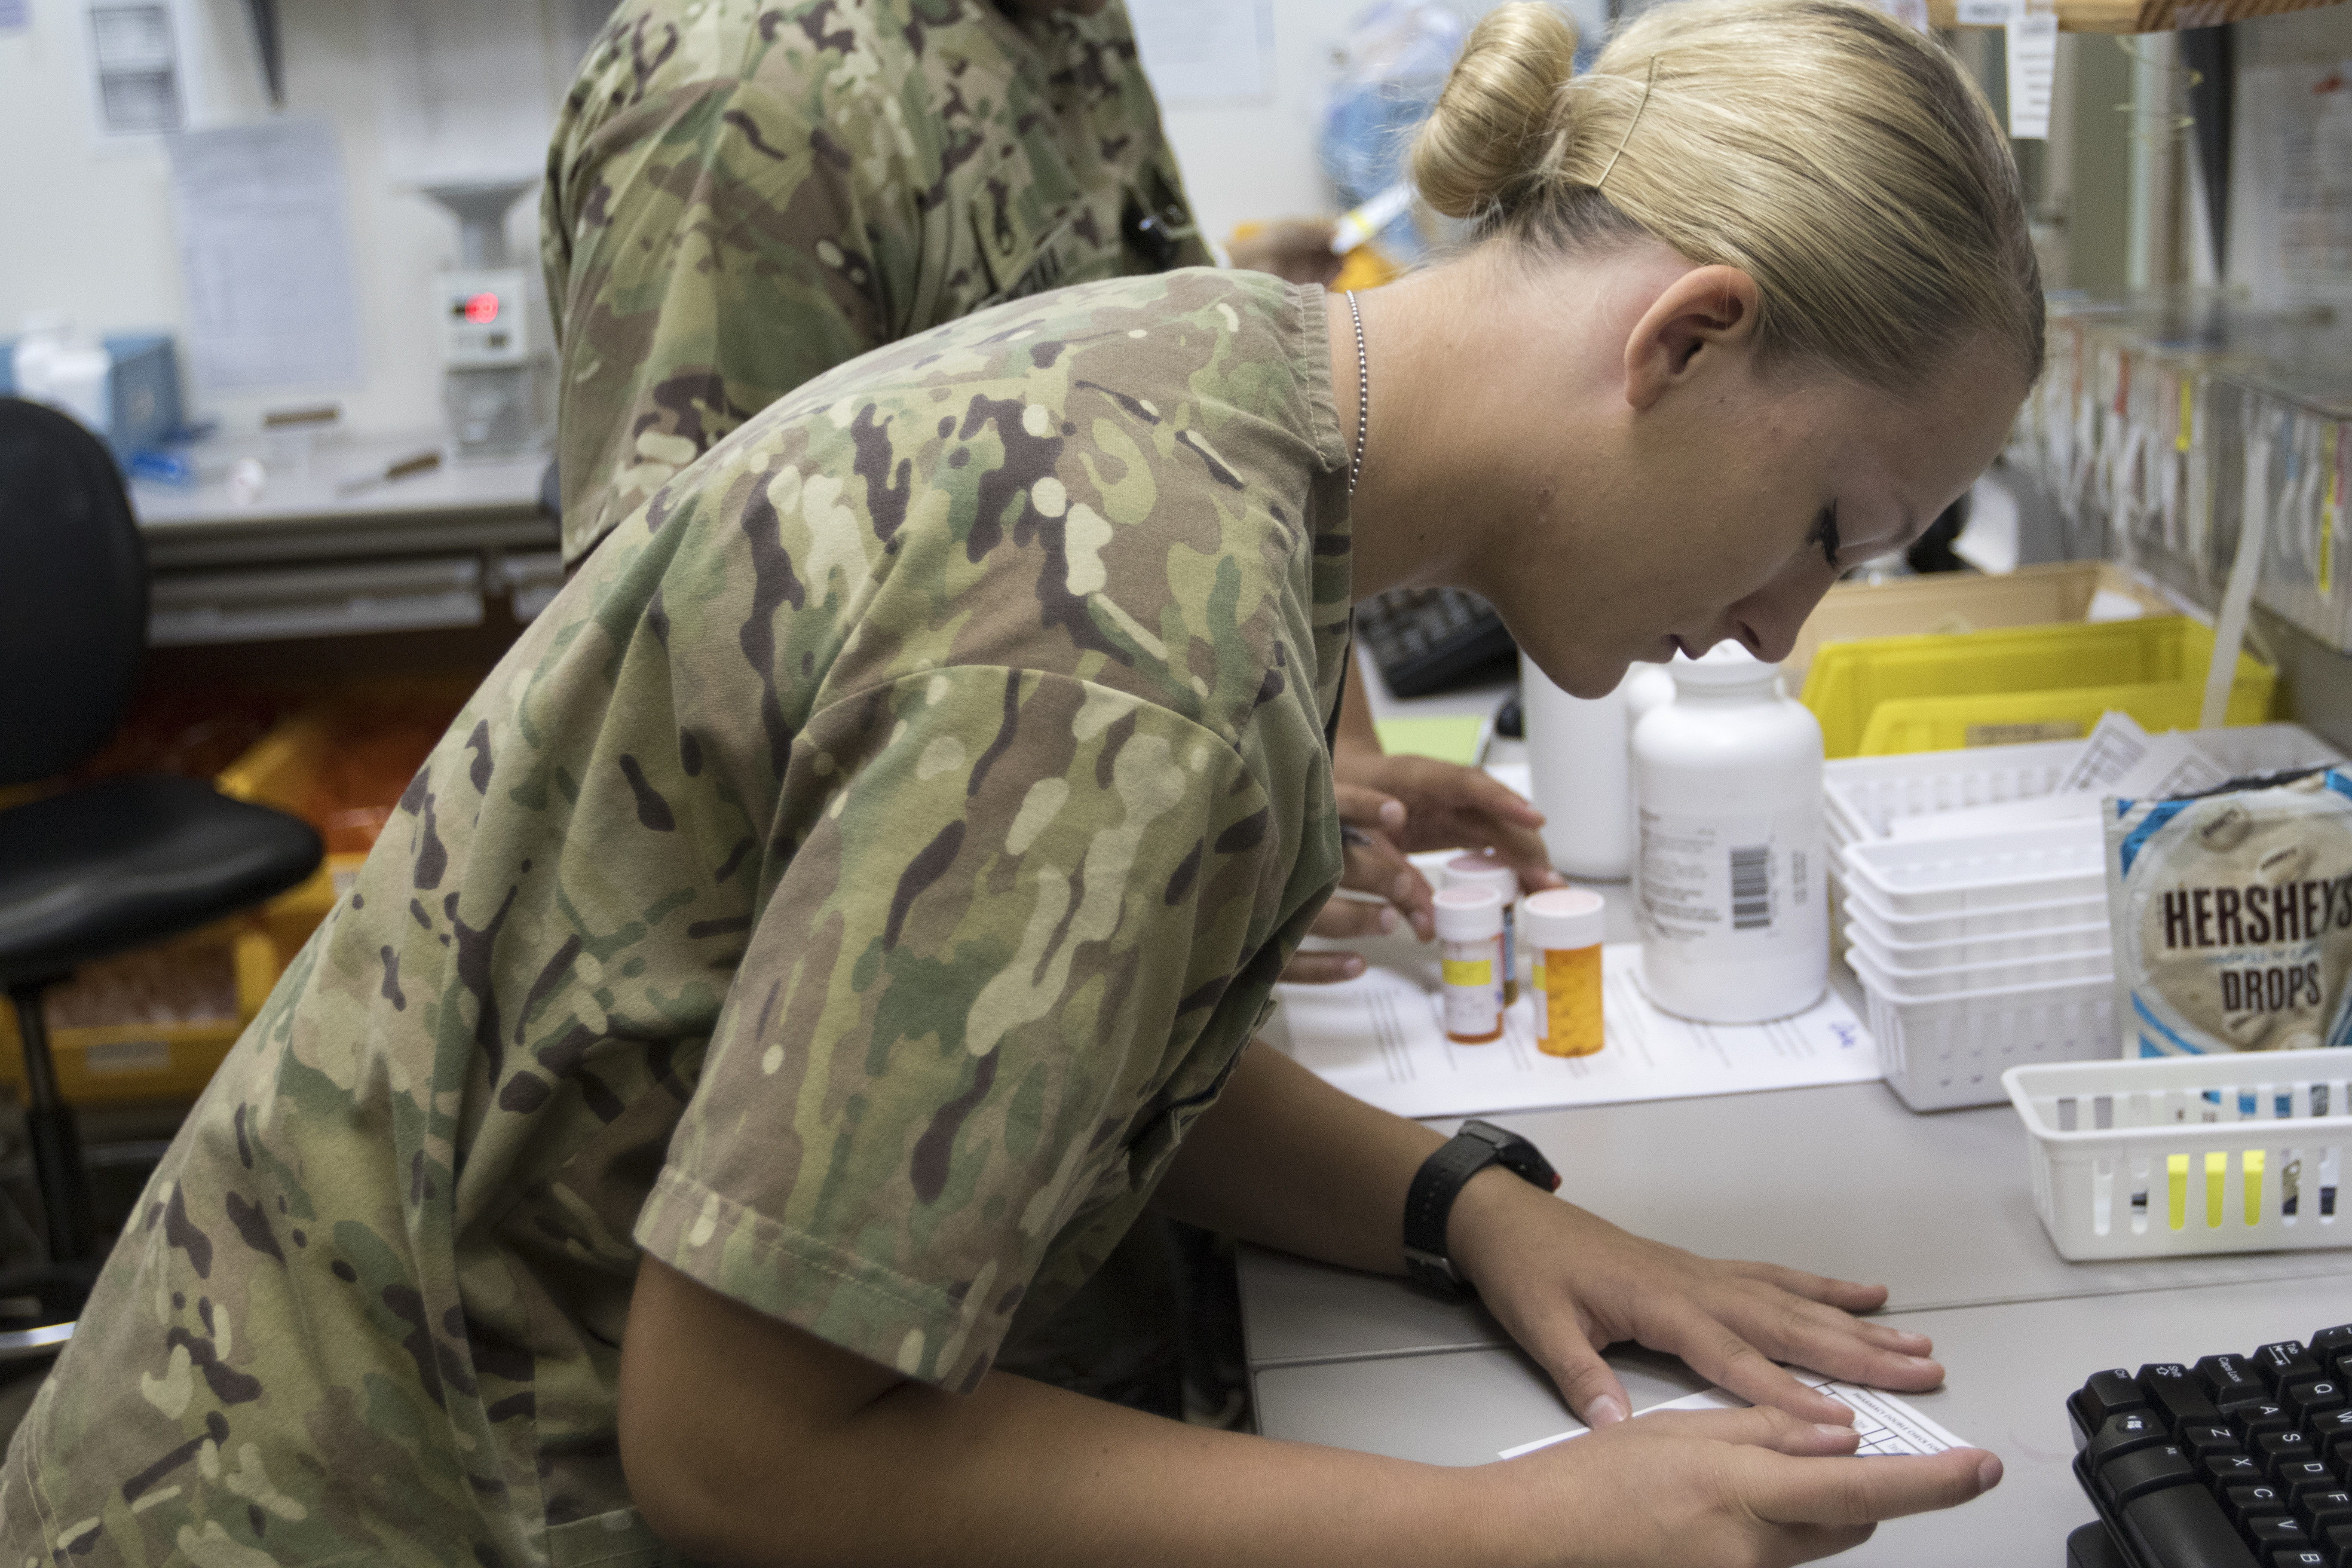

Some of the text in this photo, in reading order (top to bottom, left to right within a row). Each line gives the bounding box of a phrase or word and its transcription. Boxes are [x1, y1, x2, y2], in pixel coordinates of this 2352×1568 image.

[2221, 961, 2320, 1012] DROPS
[2286, 1342, 2299, 1354] Tab
[2114, 1369, 2128, 1378] Ctrl
[2168, 1365, 2182, 1377] Shift
[2218, 1357, 2242, 1382] Caps Lock
[2314, 1384, 2333, 1394] Q
[2260, 1406, 2278, 1415] A
[1853, 1392, 1885, 1415] PHARMACY
[1883, 1413, 1908, 1430] DOUBLE
[1907, 1430, 1927, 1443] CHECK
[2337, 1411, 2352, 1422] W
[2211, 1429, 2231, 1437] Z
[2282, 1433, 2301, 1442] S
[2303, 1463, 2323, 1472] D
[2254, 1488, 2273, 1498] C
[2328, 1493, 2348, 1501] F
[2278, 1520, 2297, 1529] V
[2300, 1554, 2320, 1562] B
